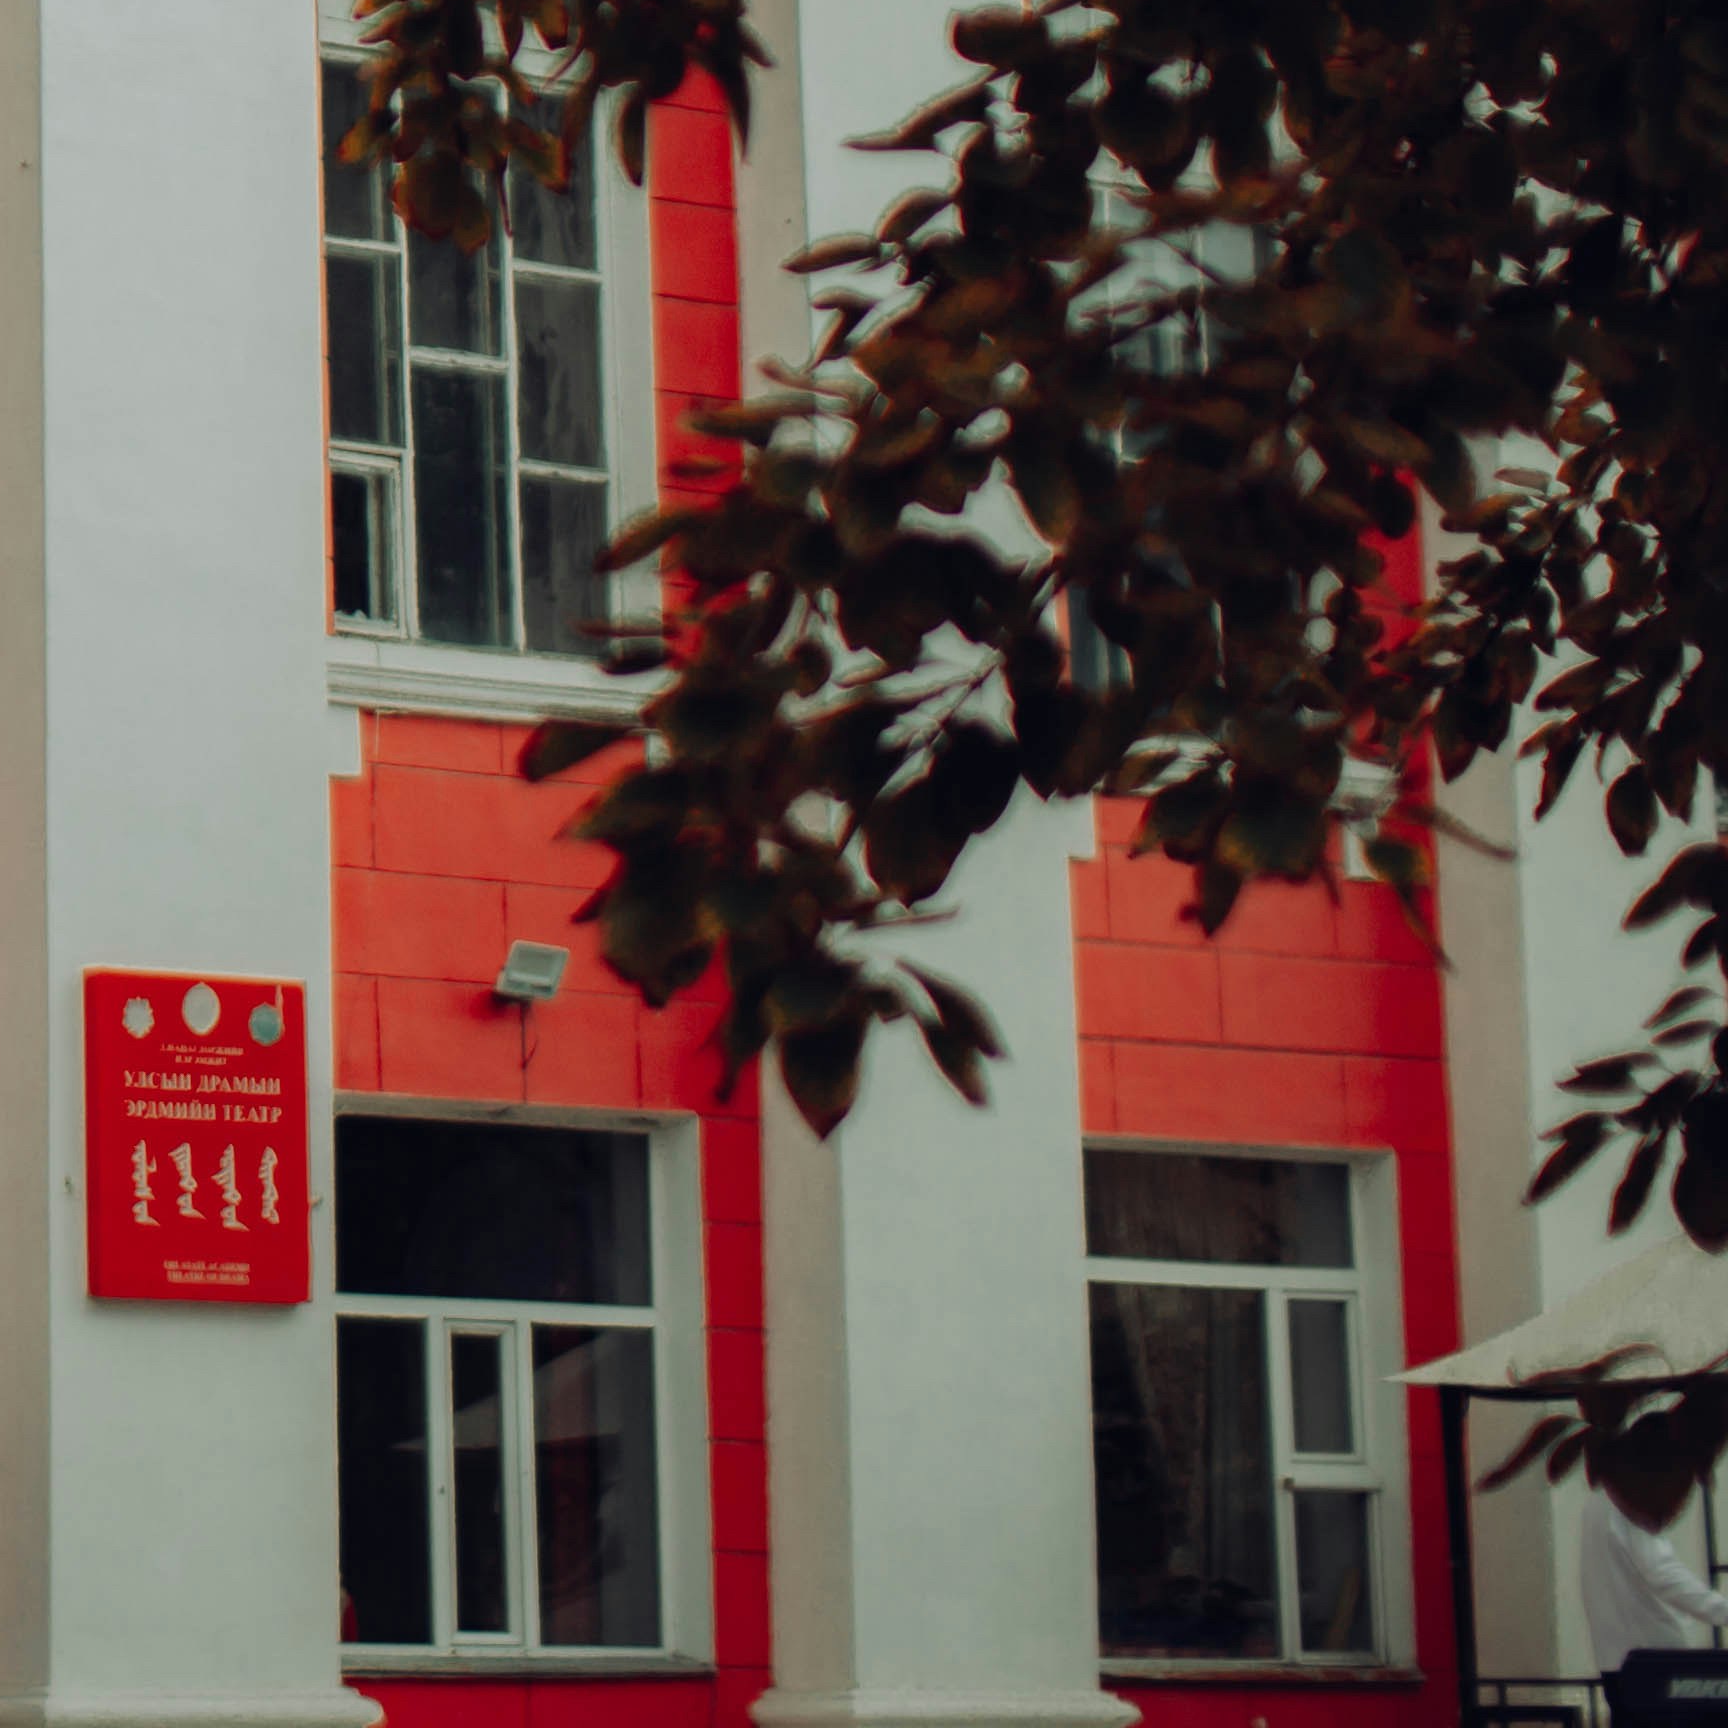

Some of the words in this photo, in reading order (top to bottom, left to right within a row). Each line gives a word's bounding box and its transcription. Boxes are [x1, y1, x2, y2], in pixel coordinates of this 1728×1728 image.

[124, 1071, 192, 1091] УЛСЫН
[197, 1075, 281, 1095] ДРАМЫН
[124, 1099, 216, 1120] ЭРДМИЙН
[223, 1105, 282, 1122] ТЕАТР
